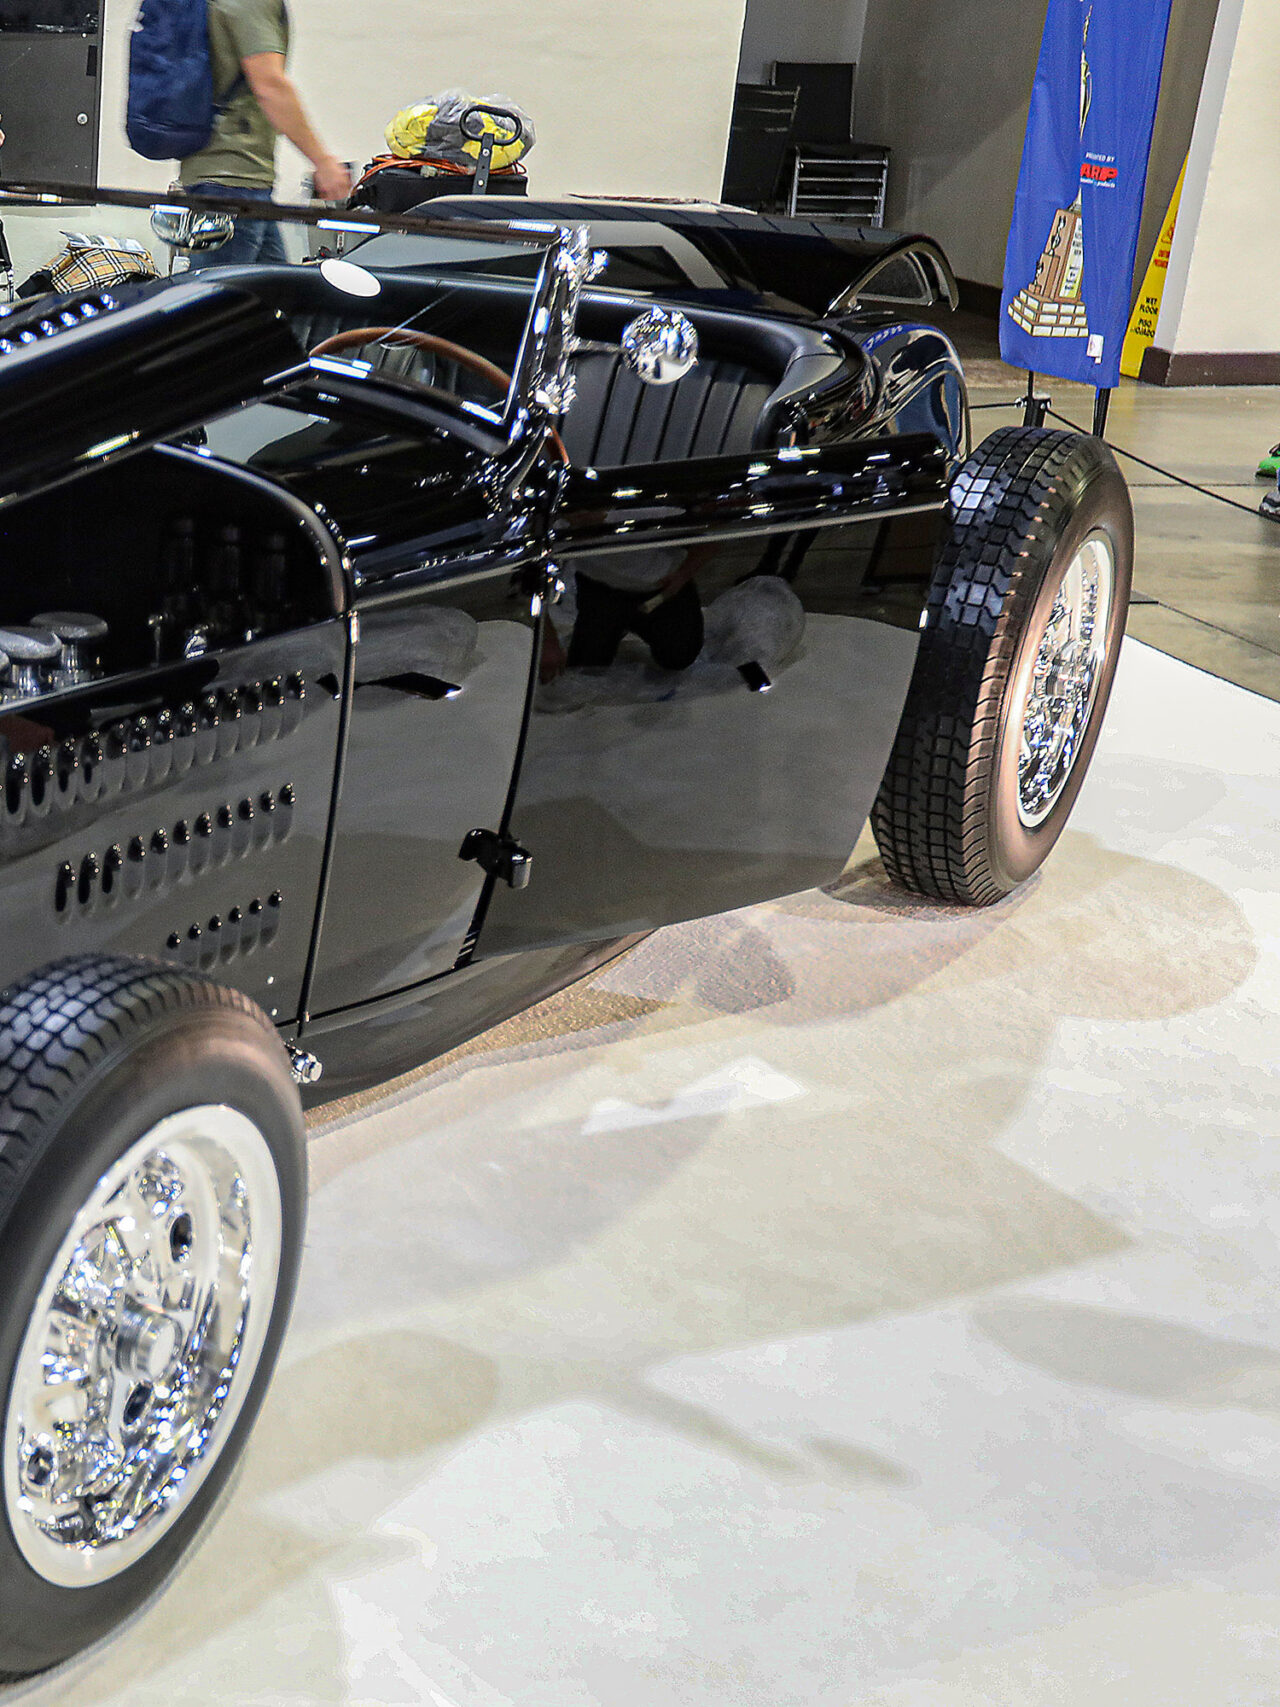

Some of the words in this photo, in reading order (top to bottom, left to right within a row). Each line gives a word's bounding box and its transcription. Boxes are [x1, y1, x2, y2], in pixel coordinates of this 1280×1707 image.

[1080, 163, 1118, 182] ARP
[1146, 297, 1157, 305] WET
[1140, 304, 1158, 315] FLOOR
